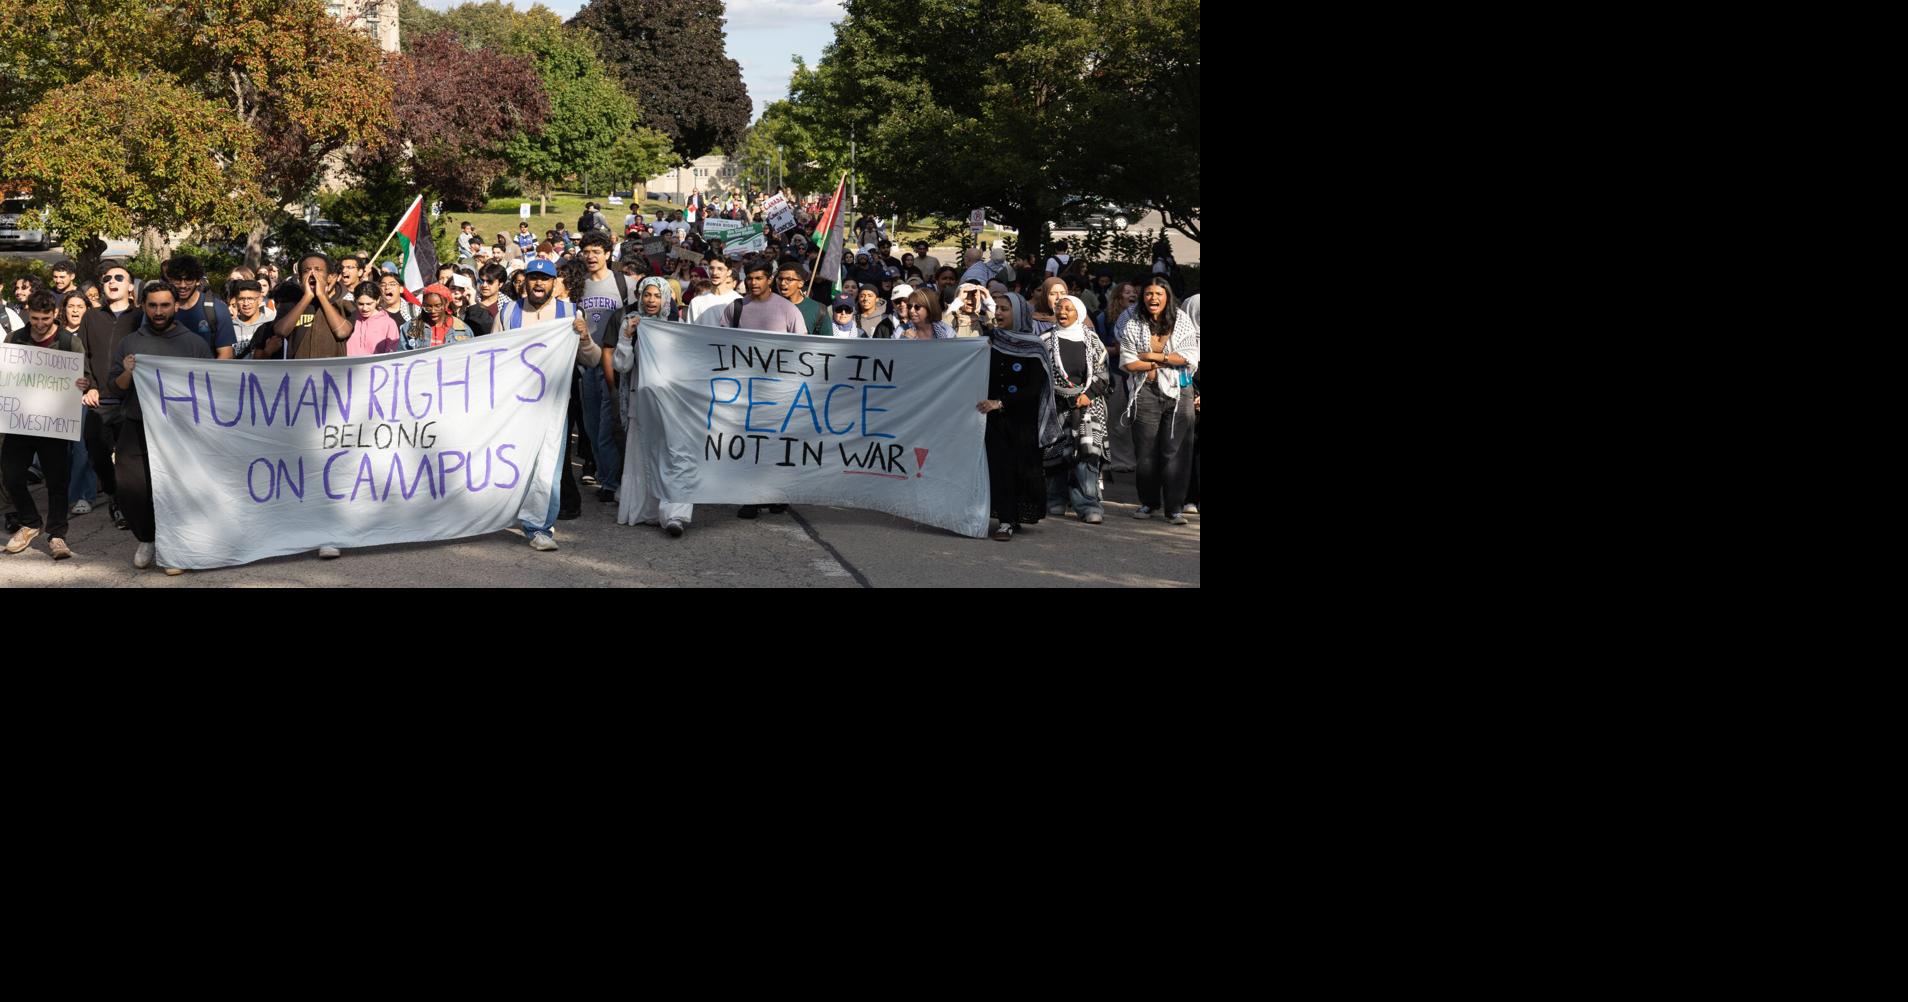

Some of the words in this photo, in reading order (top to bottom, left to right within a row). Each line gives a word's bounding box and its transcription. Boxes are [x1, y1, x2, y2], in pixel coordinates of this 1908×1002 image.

[580, 296, 617, 310] ESTERN
[36, 351, 80, 371] STUDENTS
[708, 343, 836, 381] INVEST
[846, 355, 894, 382] IN
[36, 374, 71, 392] RIGHTS
[156, 368, 353, 428] HUMAN
[368, 343, 548, 423] RIGHTS
[9, 412, 80, 433] DIVESTMENT
[706, 377, 897, 439] PEACE
[322, 421, 437, 450] BELONG
[705, 432, 769, 464] NOT
[776, 437, 823, 466] IN
[247, 455, 305, 503] ON
[323, 443, 520, 502] CAMPUS
